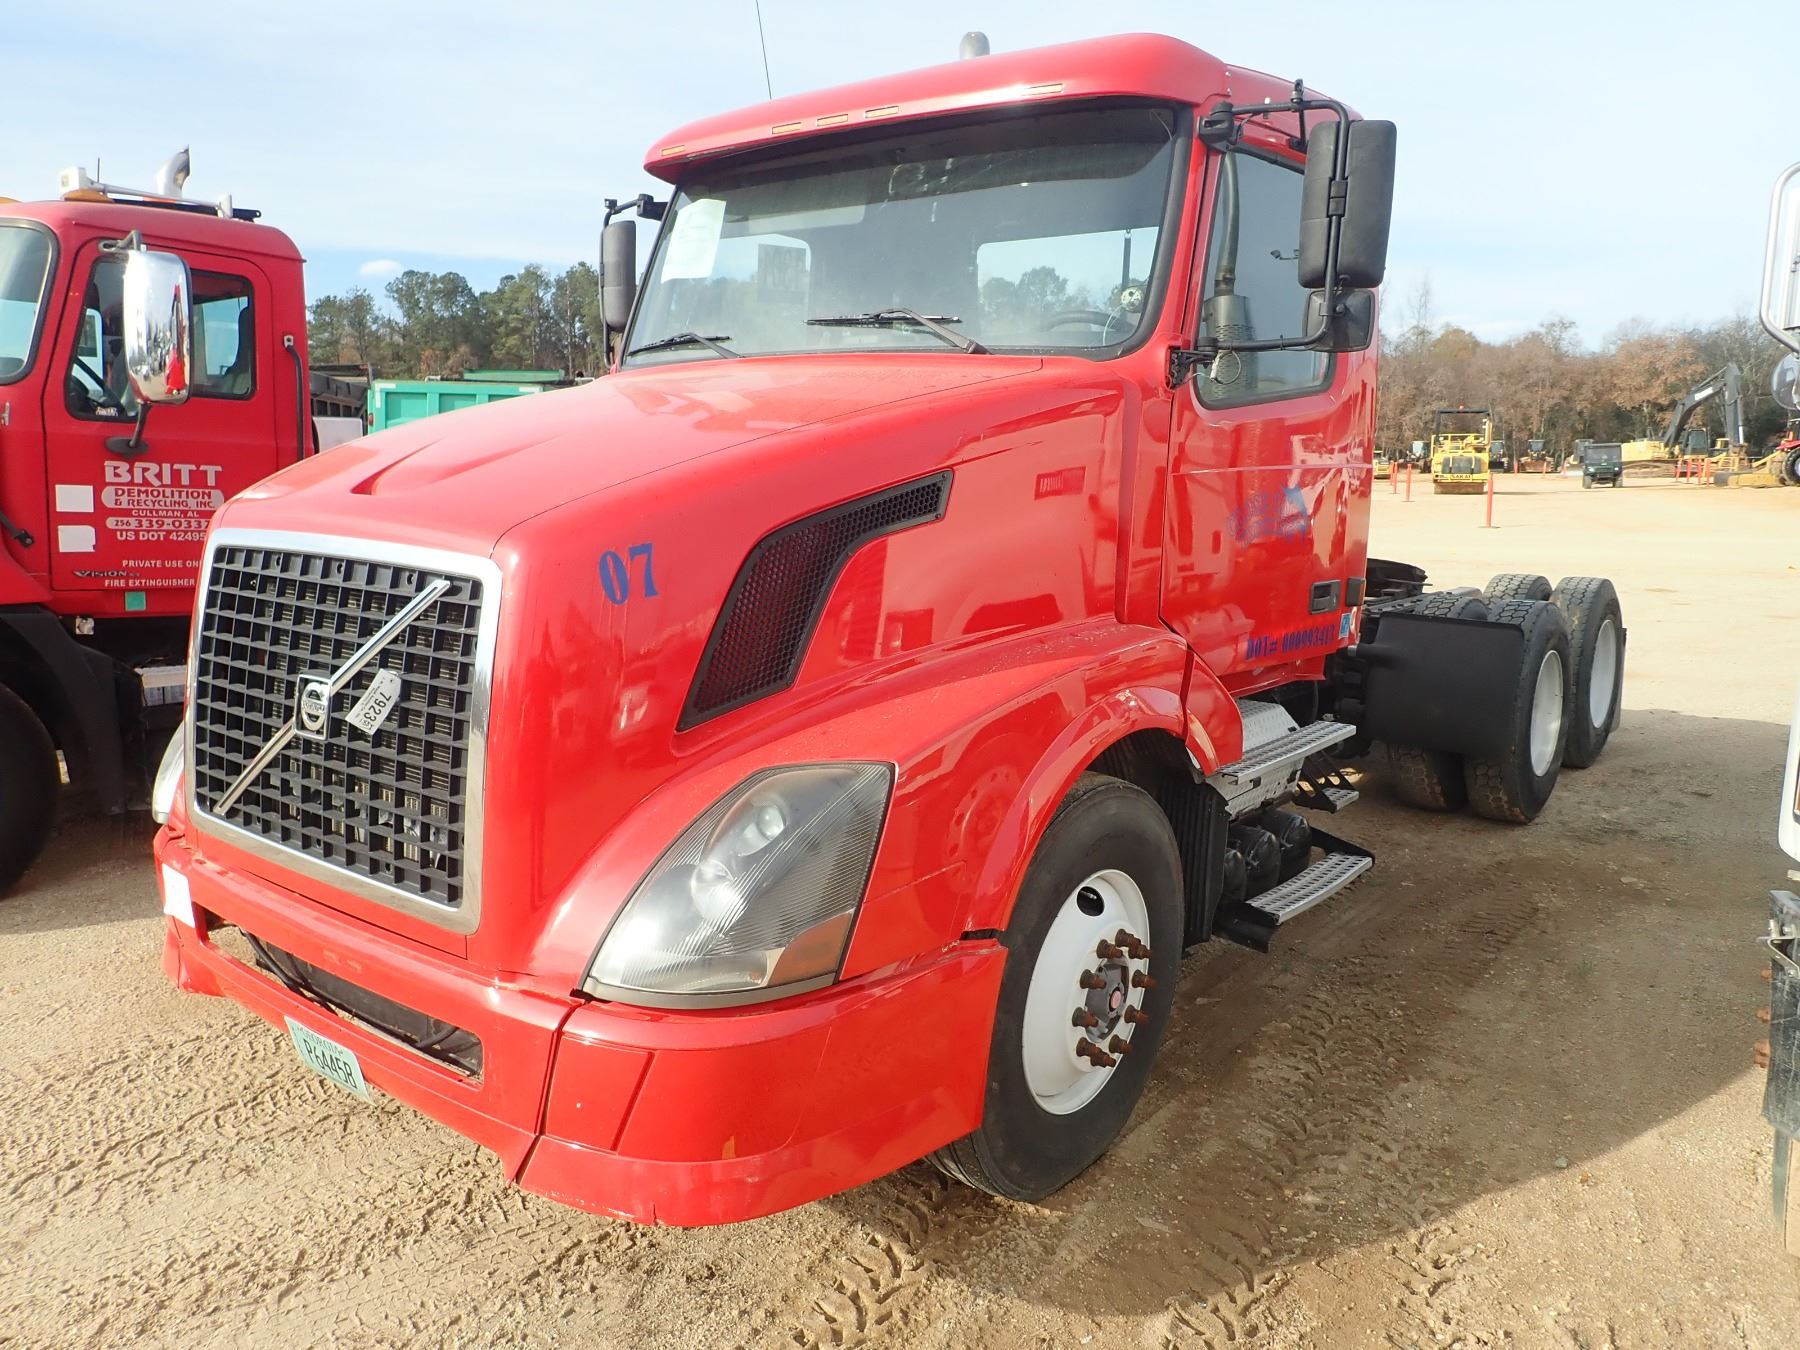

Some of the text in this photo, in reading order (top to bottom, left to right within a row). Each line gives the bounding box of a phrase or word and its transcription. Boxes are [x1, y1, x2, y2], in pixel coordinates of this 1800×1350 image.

[104, 461, 222, 487] BRITT
[114, 488, 211, 499] DEMOLITION
[114, 498, 215, 508] & RECYCLING, INC.
[132, 510, 183, 518] CULLMAN,
[135, 519, 209, 529] 339-0337
[117, 531, 135, 540] US
[140, 531, 166, 540] DOT
[122, 560, 162, 568] PRIVATE
[599, 543, 658, 605] 07
[129, 578, 195, 587] EXTINGUISHER
[363, 691, 392, 722] 7923
